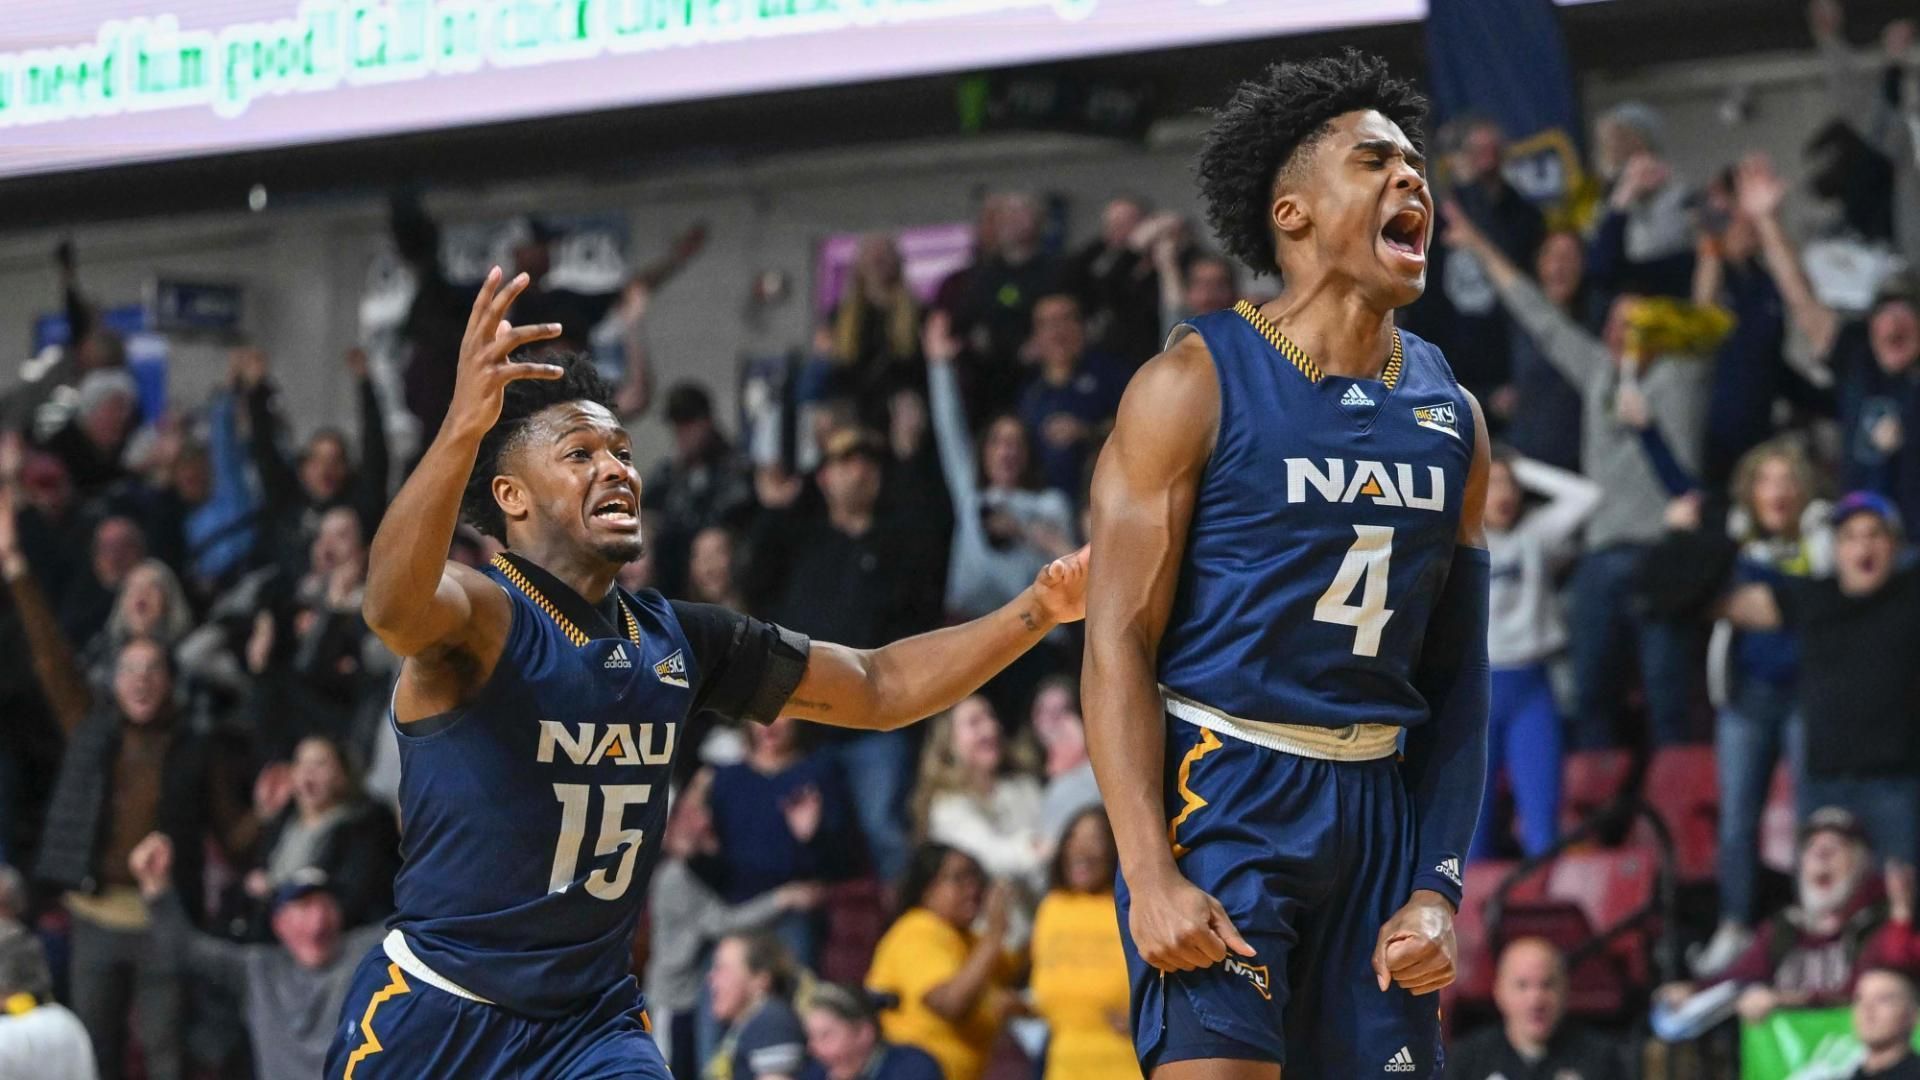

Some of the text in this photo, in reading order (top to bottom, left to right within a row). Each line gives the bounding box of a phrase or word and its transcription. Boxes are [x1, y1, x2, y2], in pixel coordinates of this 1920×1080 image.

[1340, 397, 1375, 406] adidas
[1283, 457, 1446, 512] NAU
[1313, 524, 1395, 657] 4
[604, 660, 632, 668] adidas
[537, 720, 676, 765] NAU
[548, 783, 652, 900] 15
[1384, 1062, 1416, 1072] adidas
